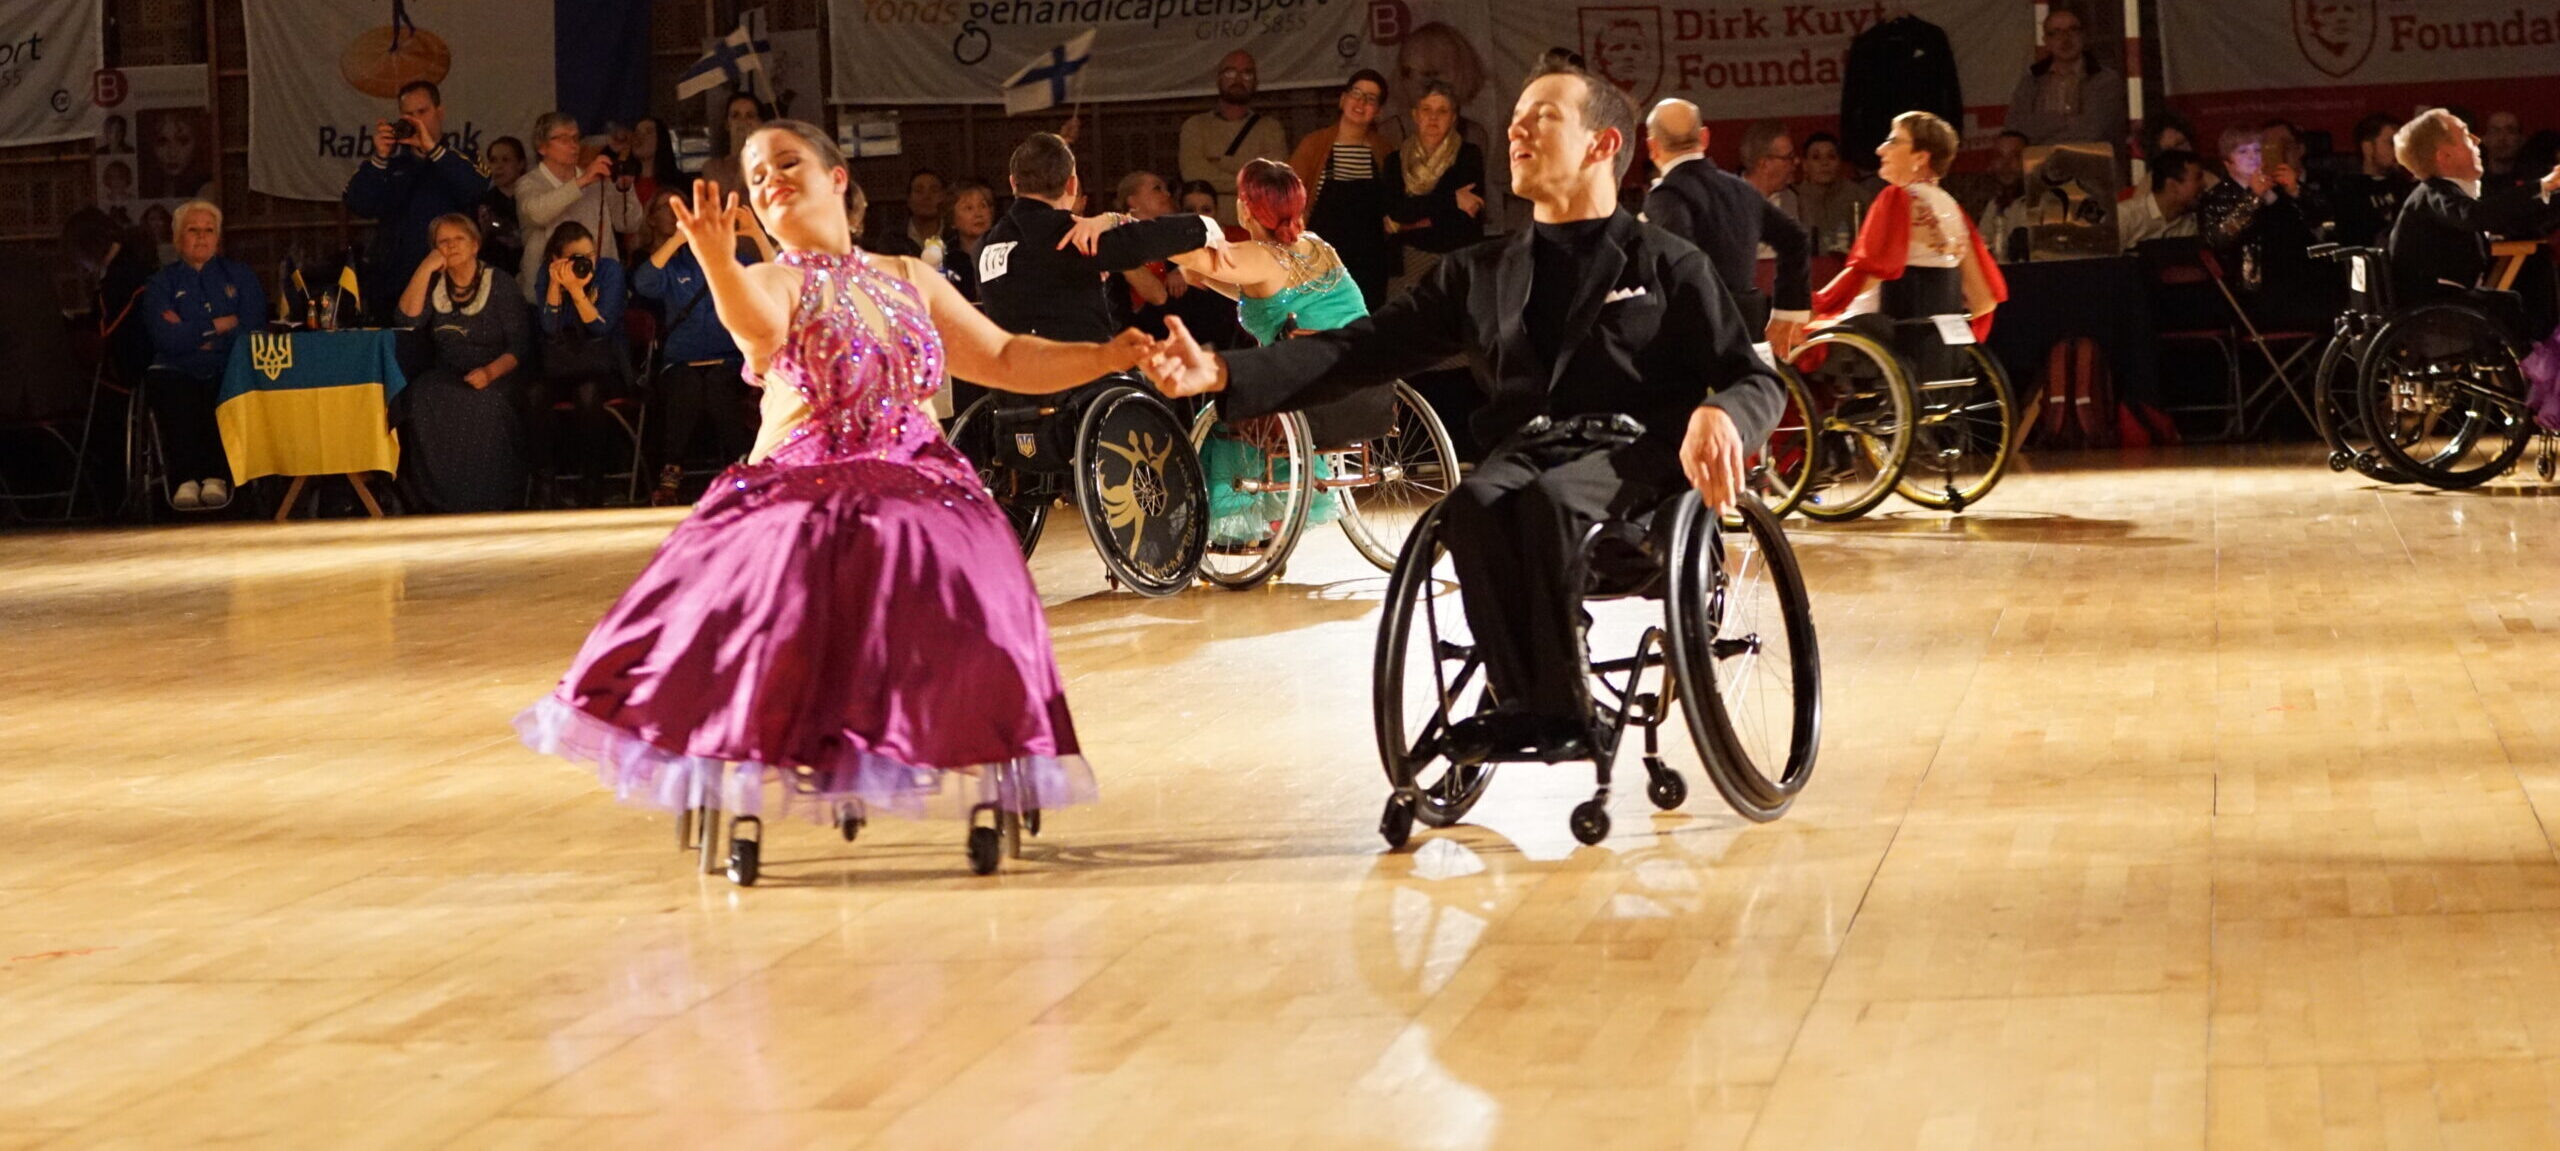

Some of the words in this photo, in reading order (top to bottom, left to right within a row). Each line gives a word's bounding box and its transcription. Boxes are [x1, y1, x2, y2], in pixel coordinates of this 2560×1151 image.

[1196, 19, 1249, 40] GIRO
[1372, 4, 1399, 38] B
[1673, 7, 1771, 40] Dirk
[2389, 9, 2560, 52] Founda
[1678, 48, 1850, 90] Founda
[98, 74, 119, 103] B
[318, 121, 482, 158] Rabnk
[985, 245, 1008, 271] 179
